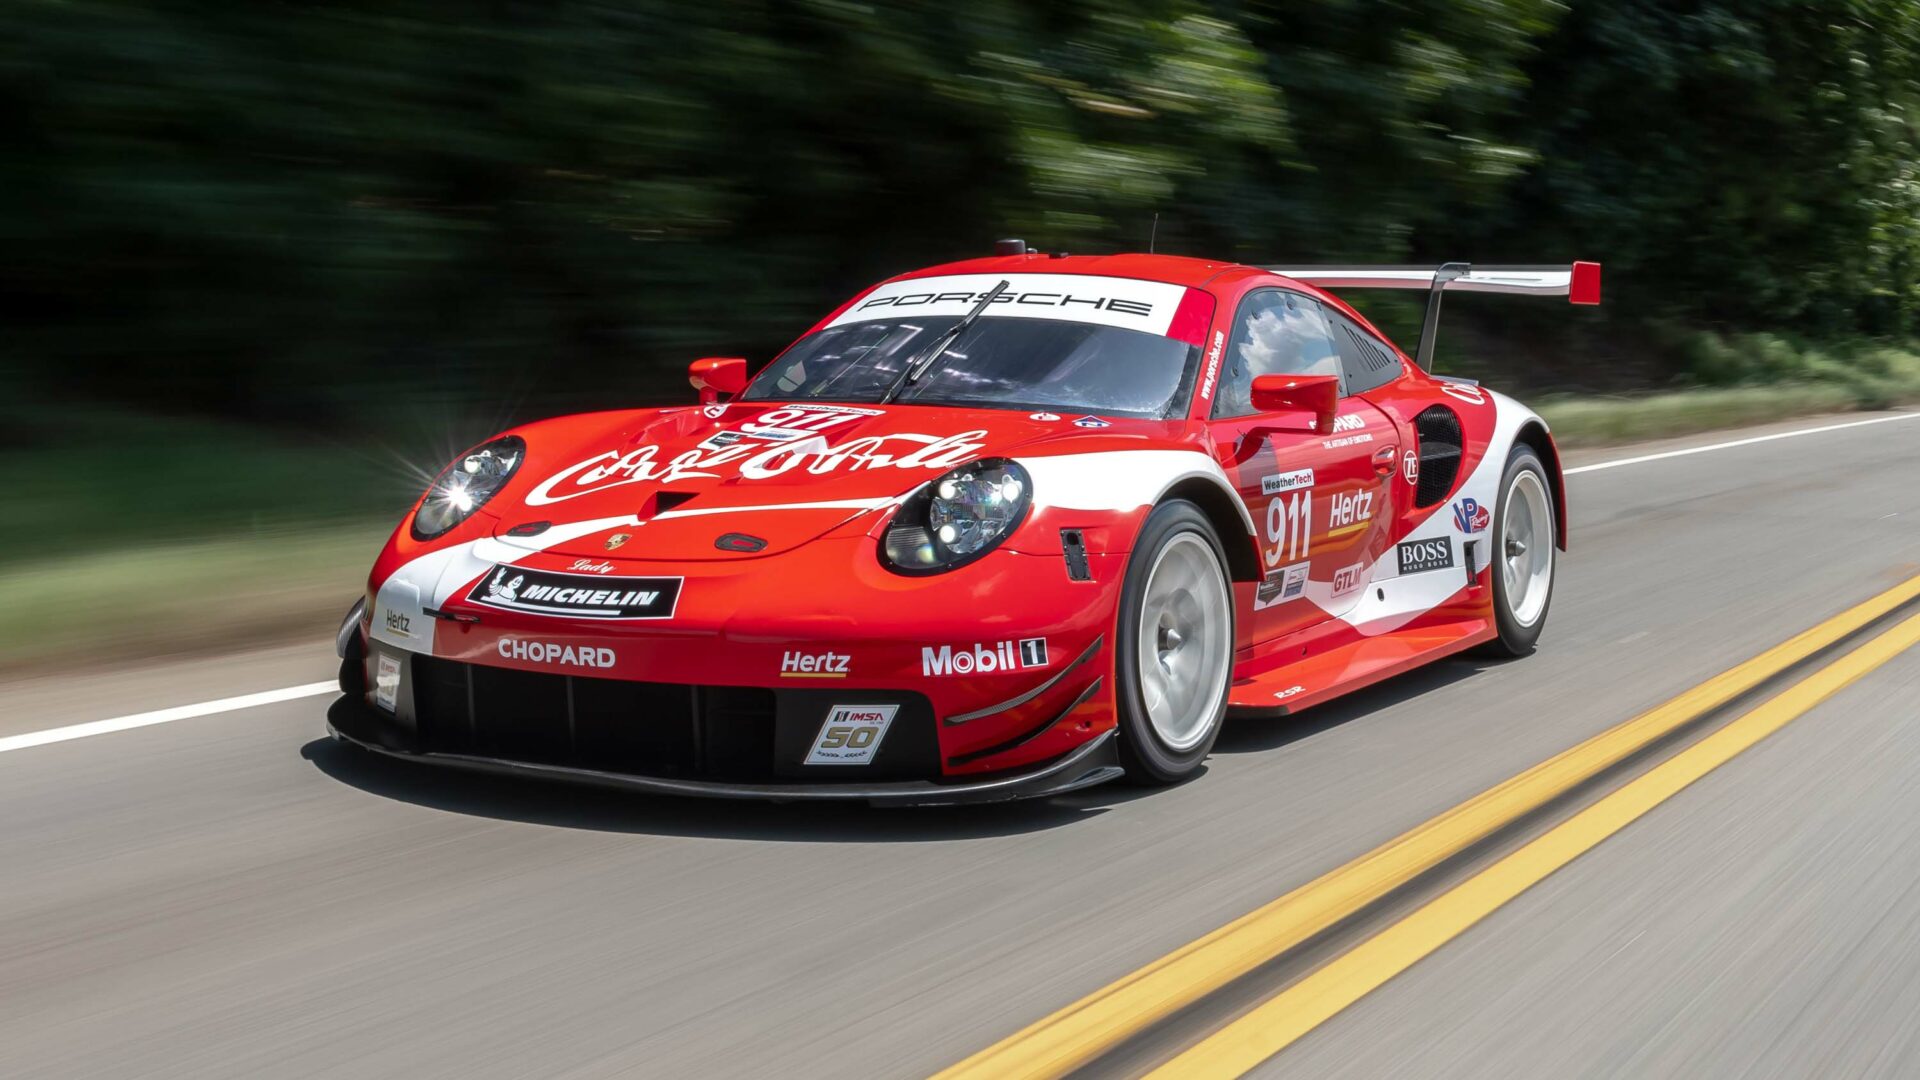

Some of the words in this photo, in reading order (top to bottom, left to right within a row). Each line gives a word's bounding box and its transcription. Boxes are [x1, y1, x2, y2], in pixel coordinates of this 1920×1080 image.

[857, 291, 1154, 318] PORSCHE
[1200, 330, 1224, 400] www.porsche.com
[741, 409, 864, 433] 911
[1263, 474, 1313, 491] WeatherTech
[1329, 488, 1373, 528] Hertz
[1452, 498, 1478, 533] VP
[1265, 490, 1312, 568] 911
[1401, 540, 1448, 565] BOSS
[567, 559, 616, 574] Lady
[1334, 566, 1362, 593] GTLM
[519, 584, 660, 606] MICHELIN
[386, 609, 411, 632] Hertz
[498, 638, 616, 668] CHOPARD
[781, 651, 849, 673] Hertz
[921, 640, 1016, 677] Mobil
[1272, 685, 1307, 699] RSR
[849, 712, 884, 721] IMSA
[821, 726, 879, 748] 50
